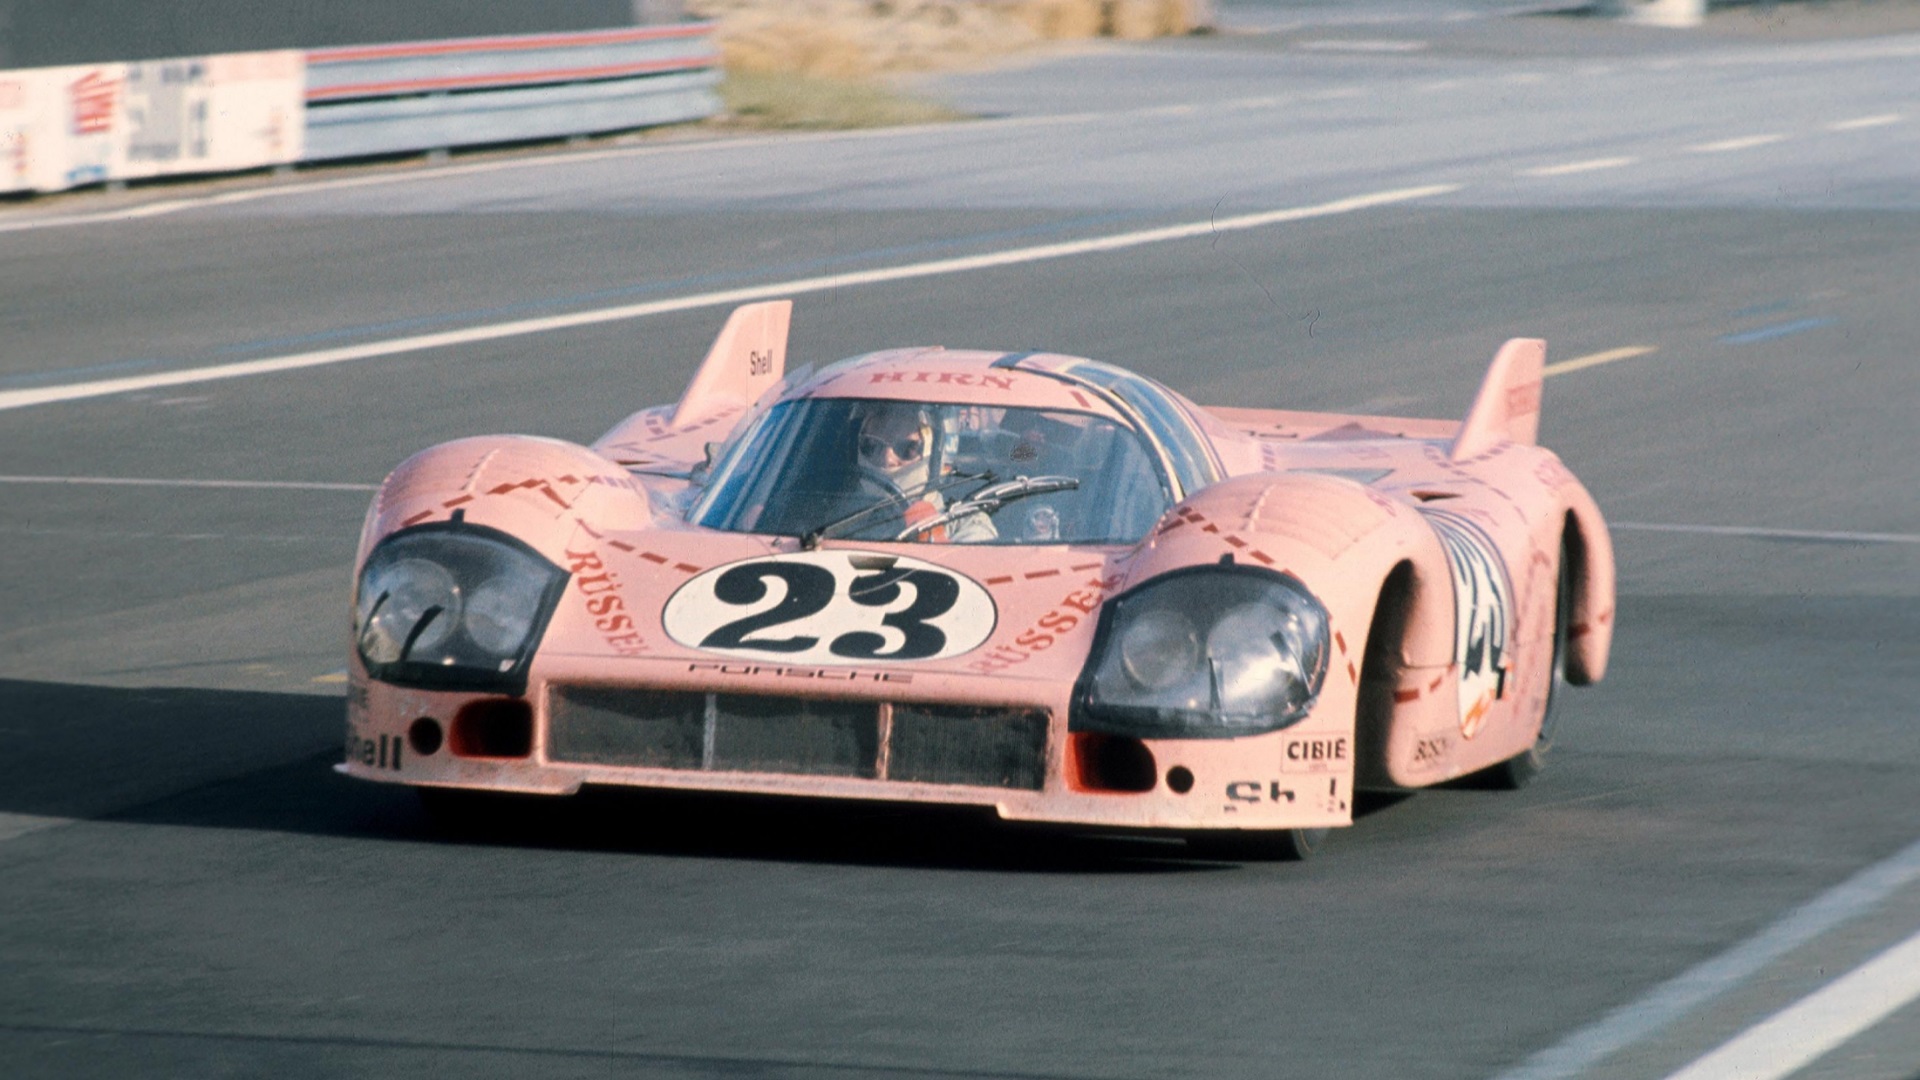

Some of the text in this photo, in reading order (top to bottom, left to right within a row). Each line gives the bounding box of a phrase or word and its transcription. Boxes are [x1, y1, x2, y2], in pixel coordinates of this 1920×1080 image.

[750, 350, 773, 376] Shell
[868, 371, 1016, 391] HIRN
[697, 561, 960, 661] 23
